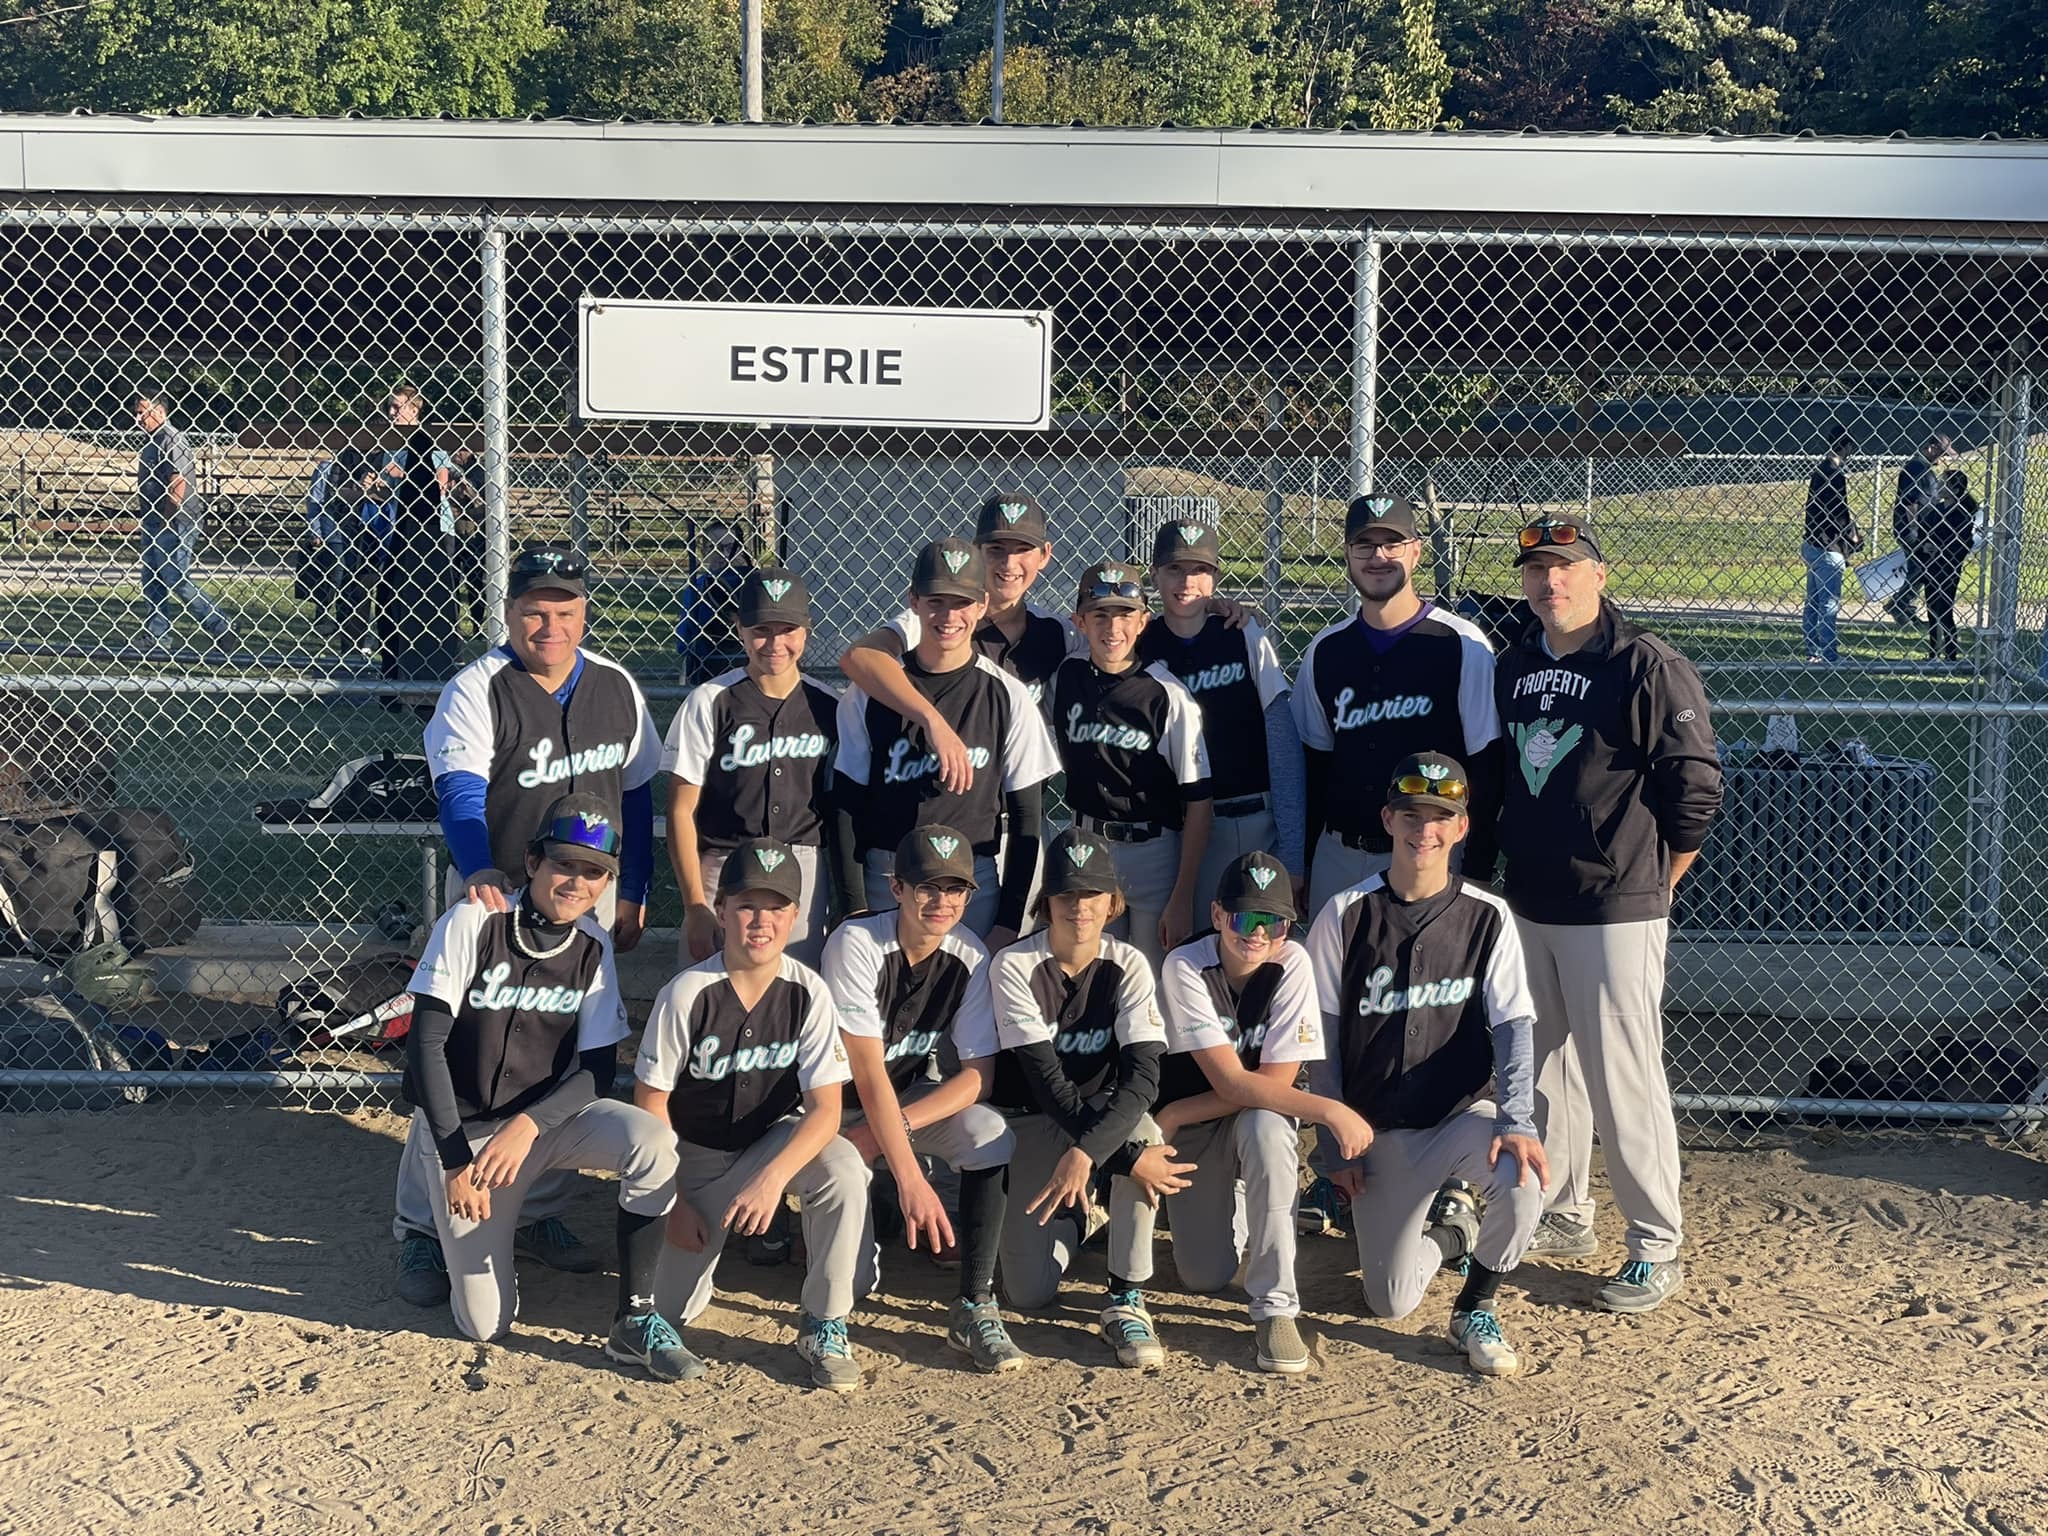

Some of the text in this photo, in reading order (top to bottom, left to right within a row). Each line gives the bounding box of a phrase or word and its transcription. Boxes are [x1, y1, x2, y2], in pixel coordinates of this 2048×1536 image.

[730, 345, 903, 386] ESTRIE
[1512, 668, 1592, 701] PROPERTY
[1540, 693, 1557, 711] OF
[1066, 702, 1152, 751] Laurier
[1333, 686, 1433, 732] Laurier
[517, 737, 626, 788] Laurier
[720, 724, 829, 771] Laurier
[1359, 965, 1475, 1017] Laurier
